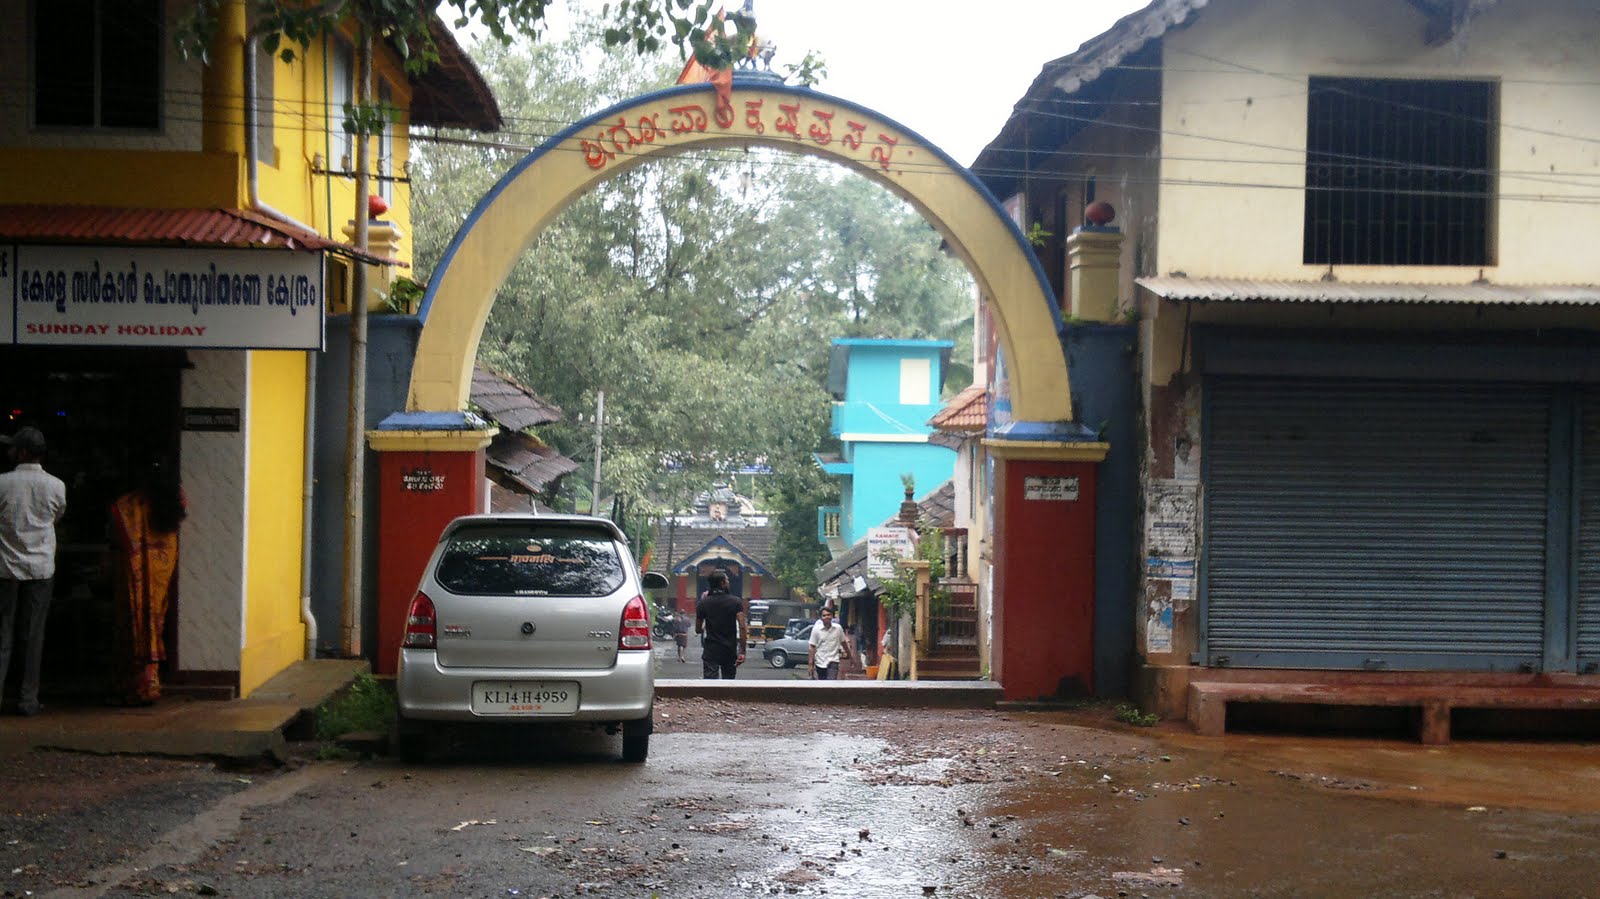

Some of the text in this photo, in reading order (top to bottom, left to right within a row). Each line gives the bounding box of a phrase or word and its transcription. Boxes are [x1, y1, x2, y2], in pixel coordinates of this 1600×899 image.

[21, 269, 66, 313] കേരള
[27, 323, 207, 336] SUNDAY HOLIDAY
